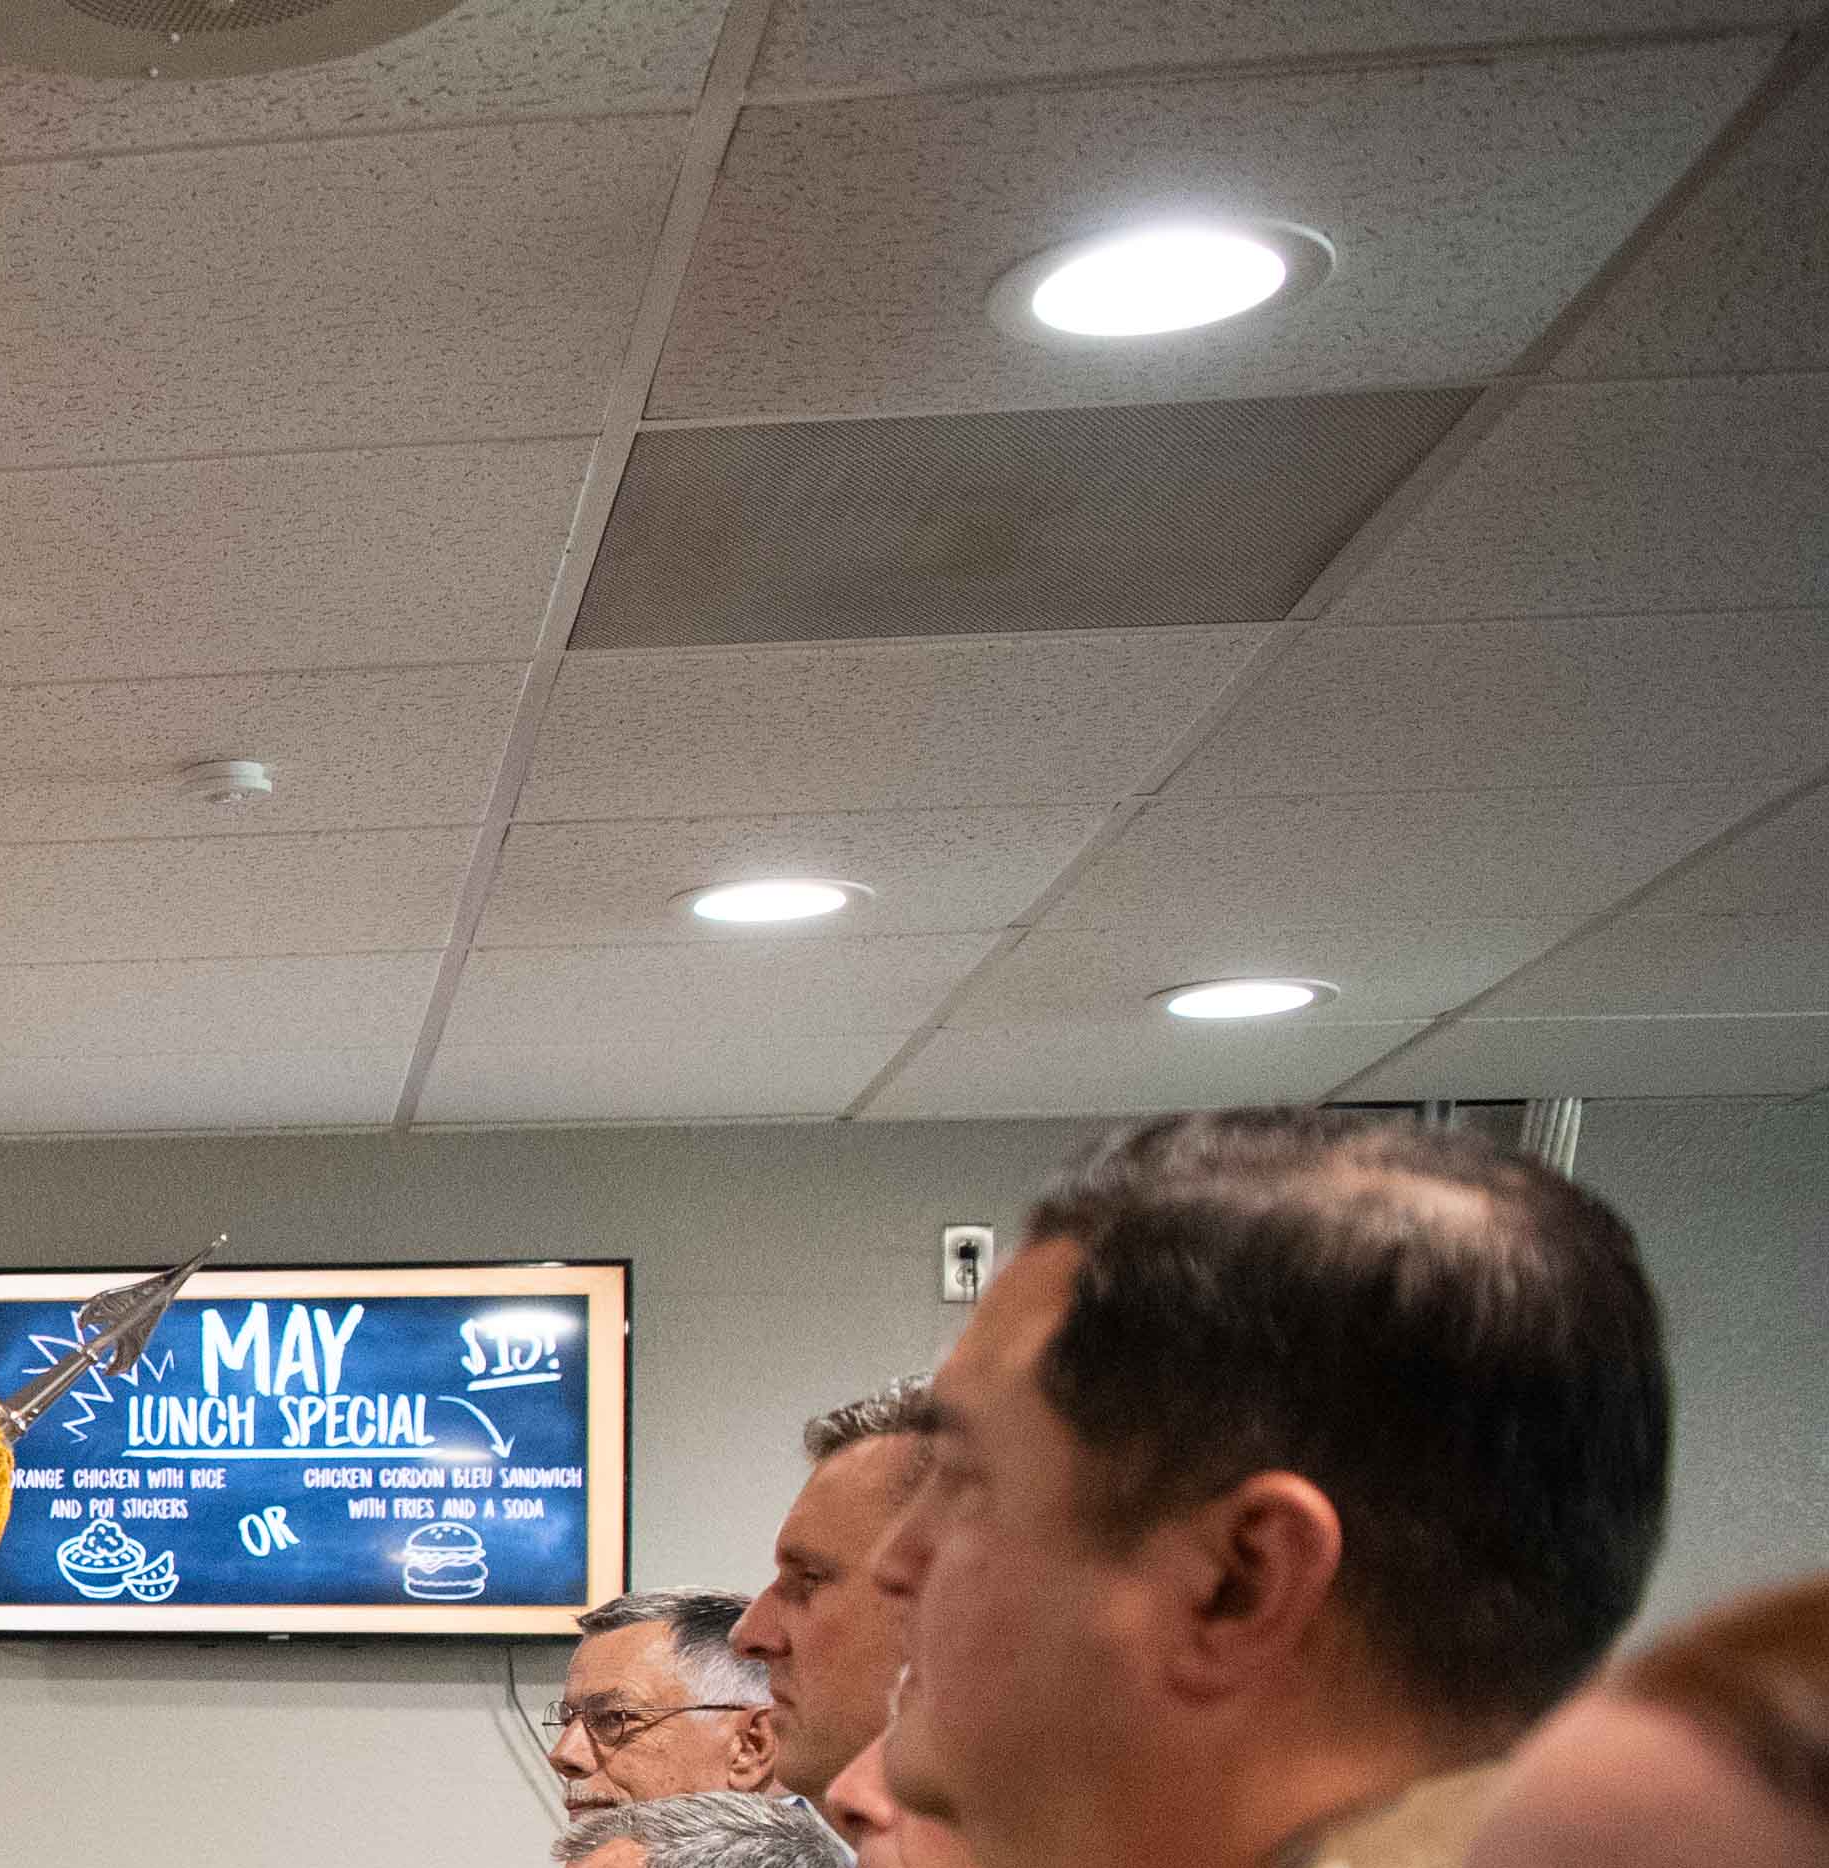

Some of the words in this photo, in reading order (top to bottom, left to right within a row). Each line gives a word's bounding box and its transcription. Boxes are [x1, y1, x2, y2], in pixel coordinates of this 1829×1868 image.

[201, 1301, 364, 1396] MAY
[128, 1394, 255, 1446] LUNCH
[278, 1393, 436, 1447] SPECIAL
[73, 1468, 140, 1489] CHICKEN
[147, 1468, 184, 1488] WITH
[190, 1468, 227, 1489] RICE
[303, 1467, 373, 1489] CHICKEN
[379, 1467, 445, 1489] CORDON
[451, 1467, 493, 1489] BLEU
[499, 1467, 583, 1489] SANDWICH
[50, 1498, 82, 1519] AND
[89, 1497, 116, 1519] POT
[122, 1498, 189, 1519] STICKERS
[348, 1498, 386, 1519] WITH
[393, 1498, 435, 1519] FRIES
[442, 1498, 476, 1519] AND
[483, 1498, 495, 1519] A
[502, 1498, 544, 1519] SODA
[238, 1506, 301, 1557] OR
